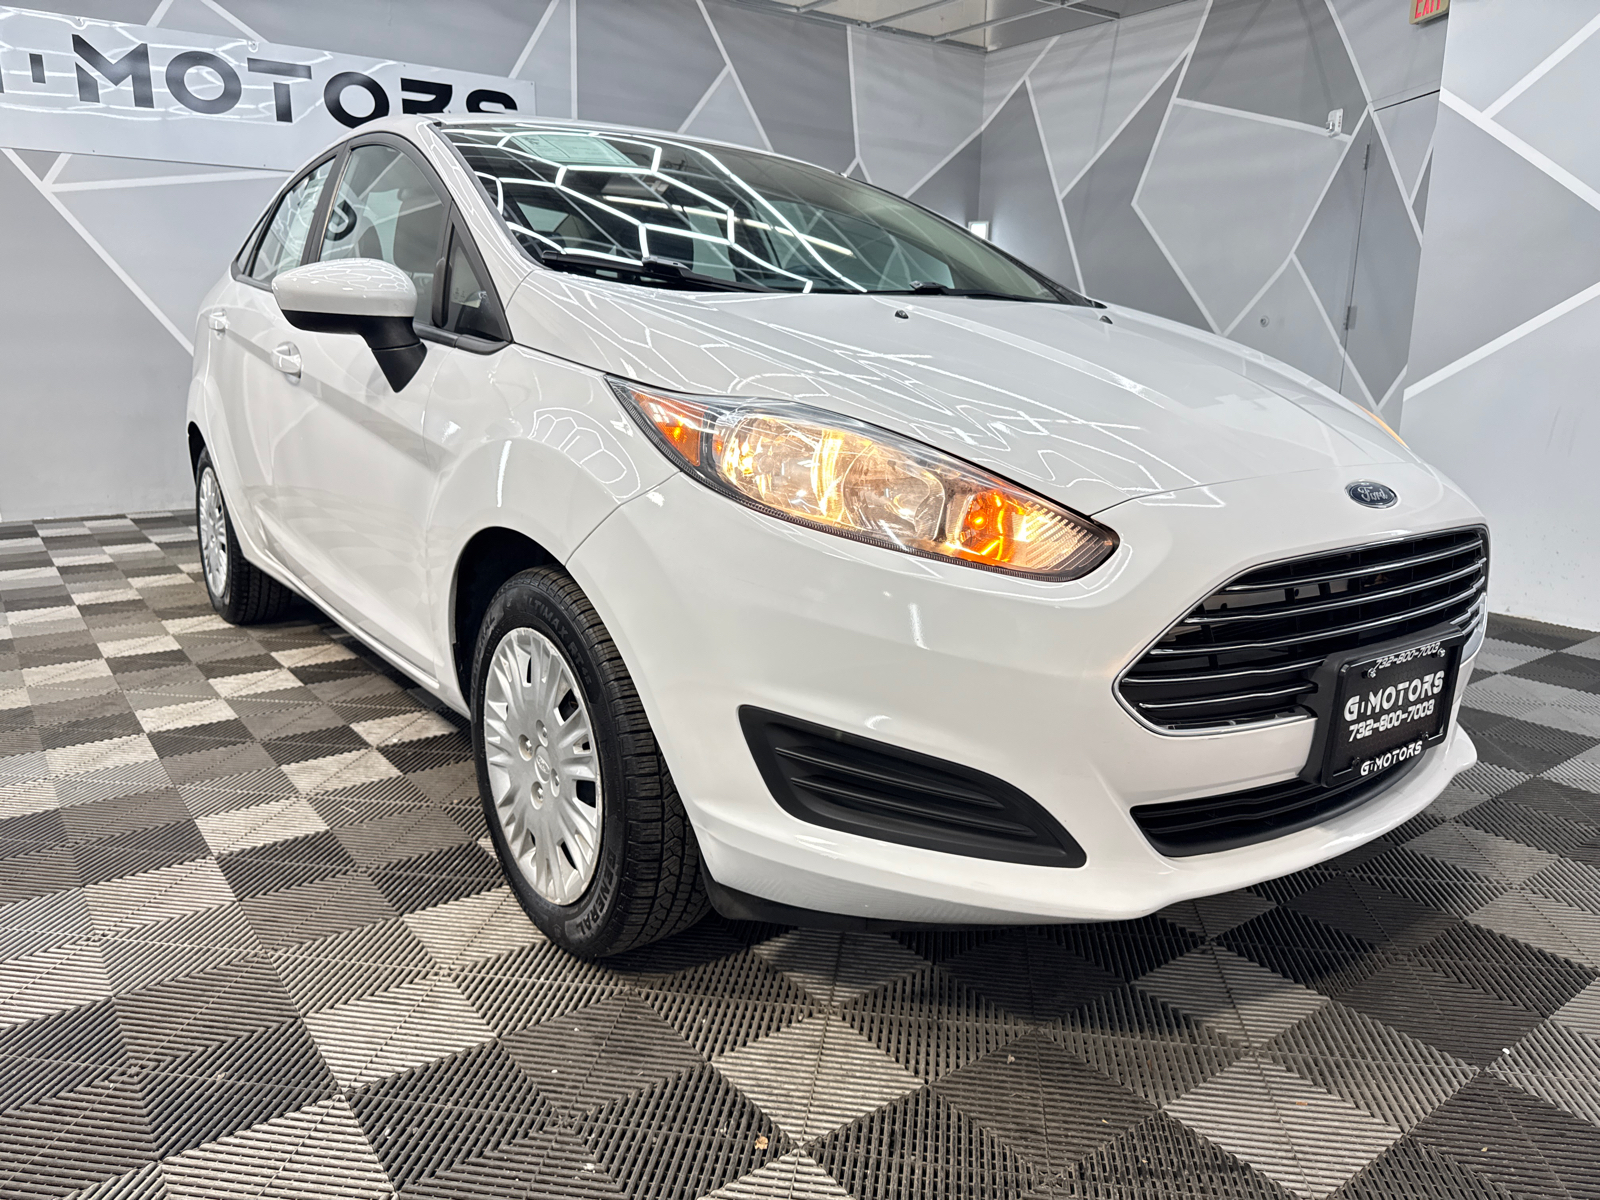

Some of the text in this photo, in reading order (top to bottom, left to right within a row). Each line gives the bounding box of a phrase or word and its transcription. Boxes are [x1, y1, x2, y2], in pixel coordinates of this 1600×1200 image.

[1357, 486, 1388, 502] Ford
[1373, 641, 1441, 670] 732-800-7003
[1348, 698, 1435, 742] 732-800-7003
